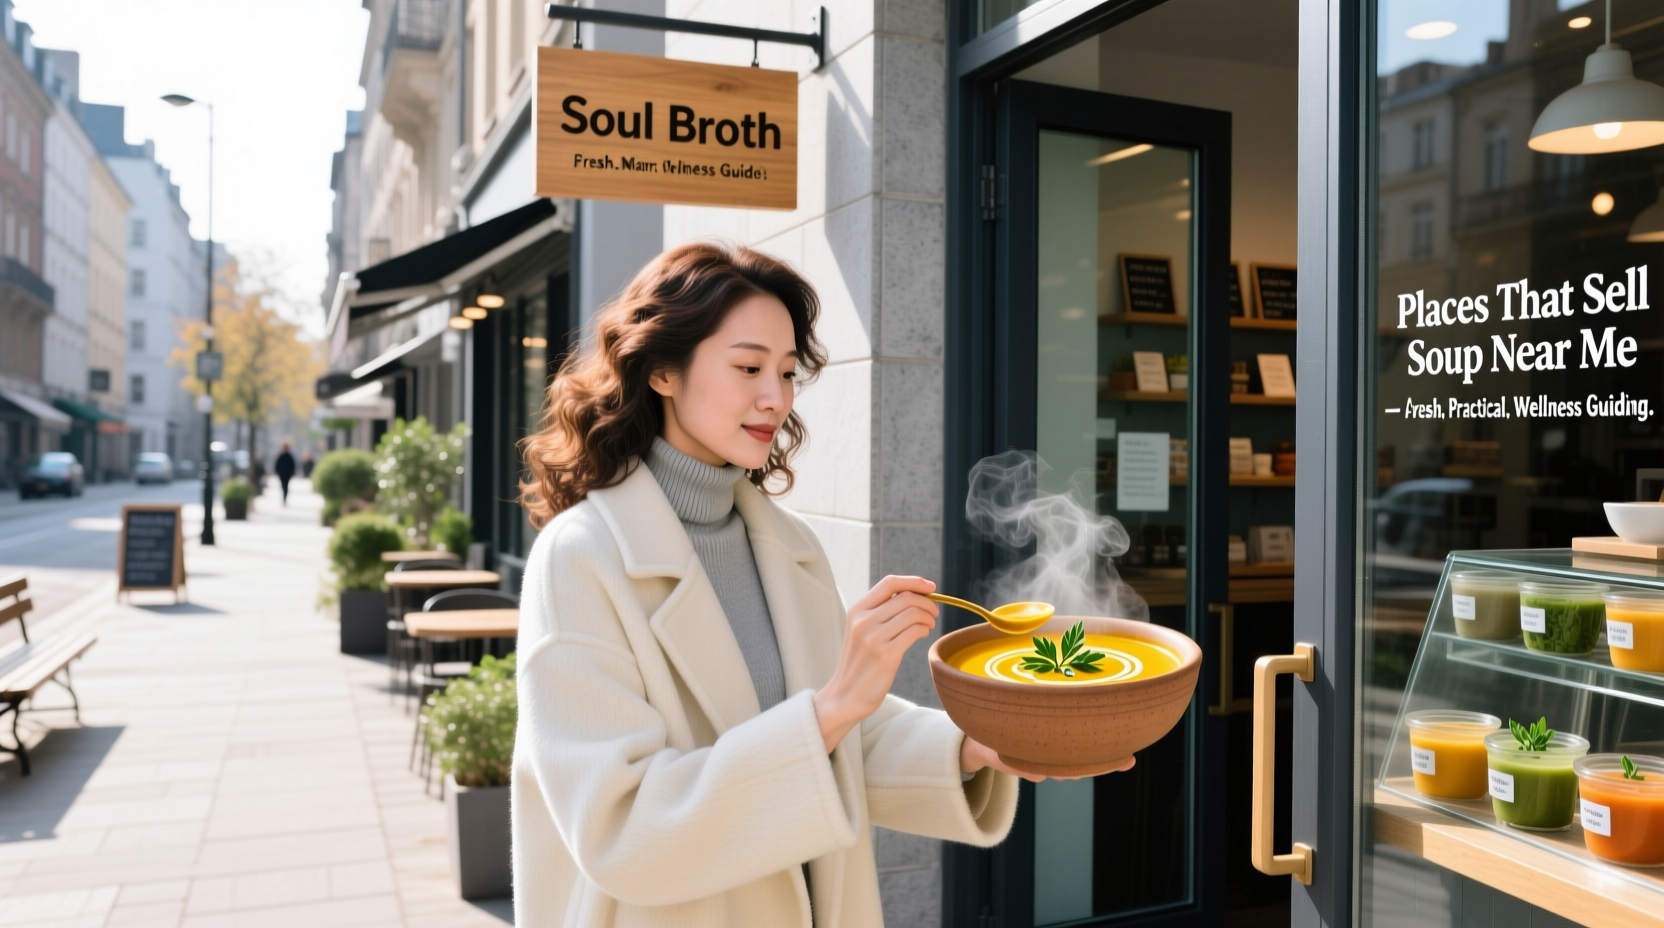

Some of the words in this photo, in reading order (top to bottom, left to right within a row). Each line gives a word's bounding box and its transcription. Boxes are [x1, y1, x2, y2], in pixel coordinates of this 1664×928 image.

[561, 95, 653, 140] Soul
[669, 104, 781, 150] Broth
[1397, 289, 1489, 329] Places
[1496, 278, 1574, 321] That
[1583, 264, 1650, 314] Sell
[1407, 339, 1483, 384] Soup
[1490, 333, 1572, 372] Near
[1579, 326, 1638, 369] Me
[1448, 395, 1510, 420] Practical,
[1513, 394, 1582, 418] Wellness
[1586, 391, 1654, 422] Guiding.
